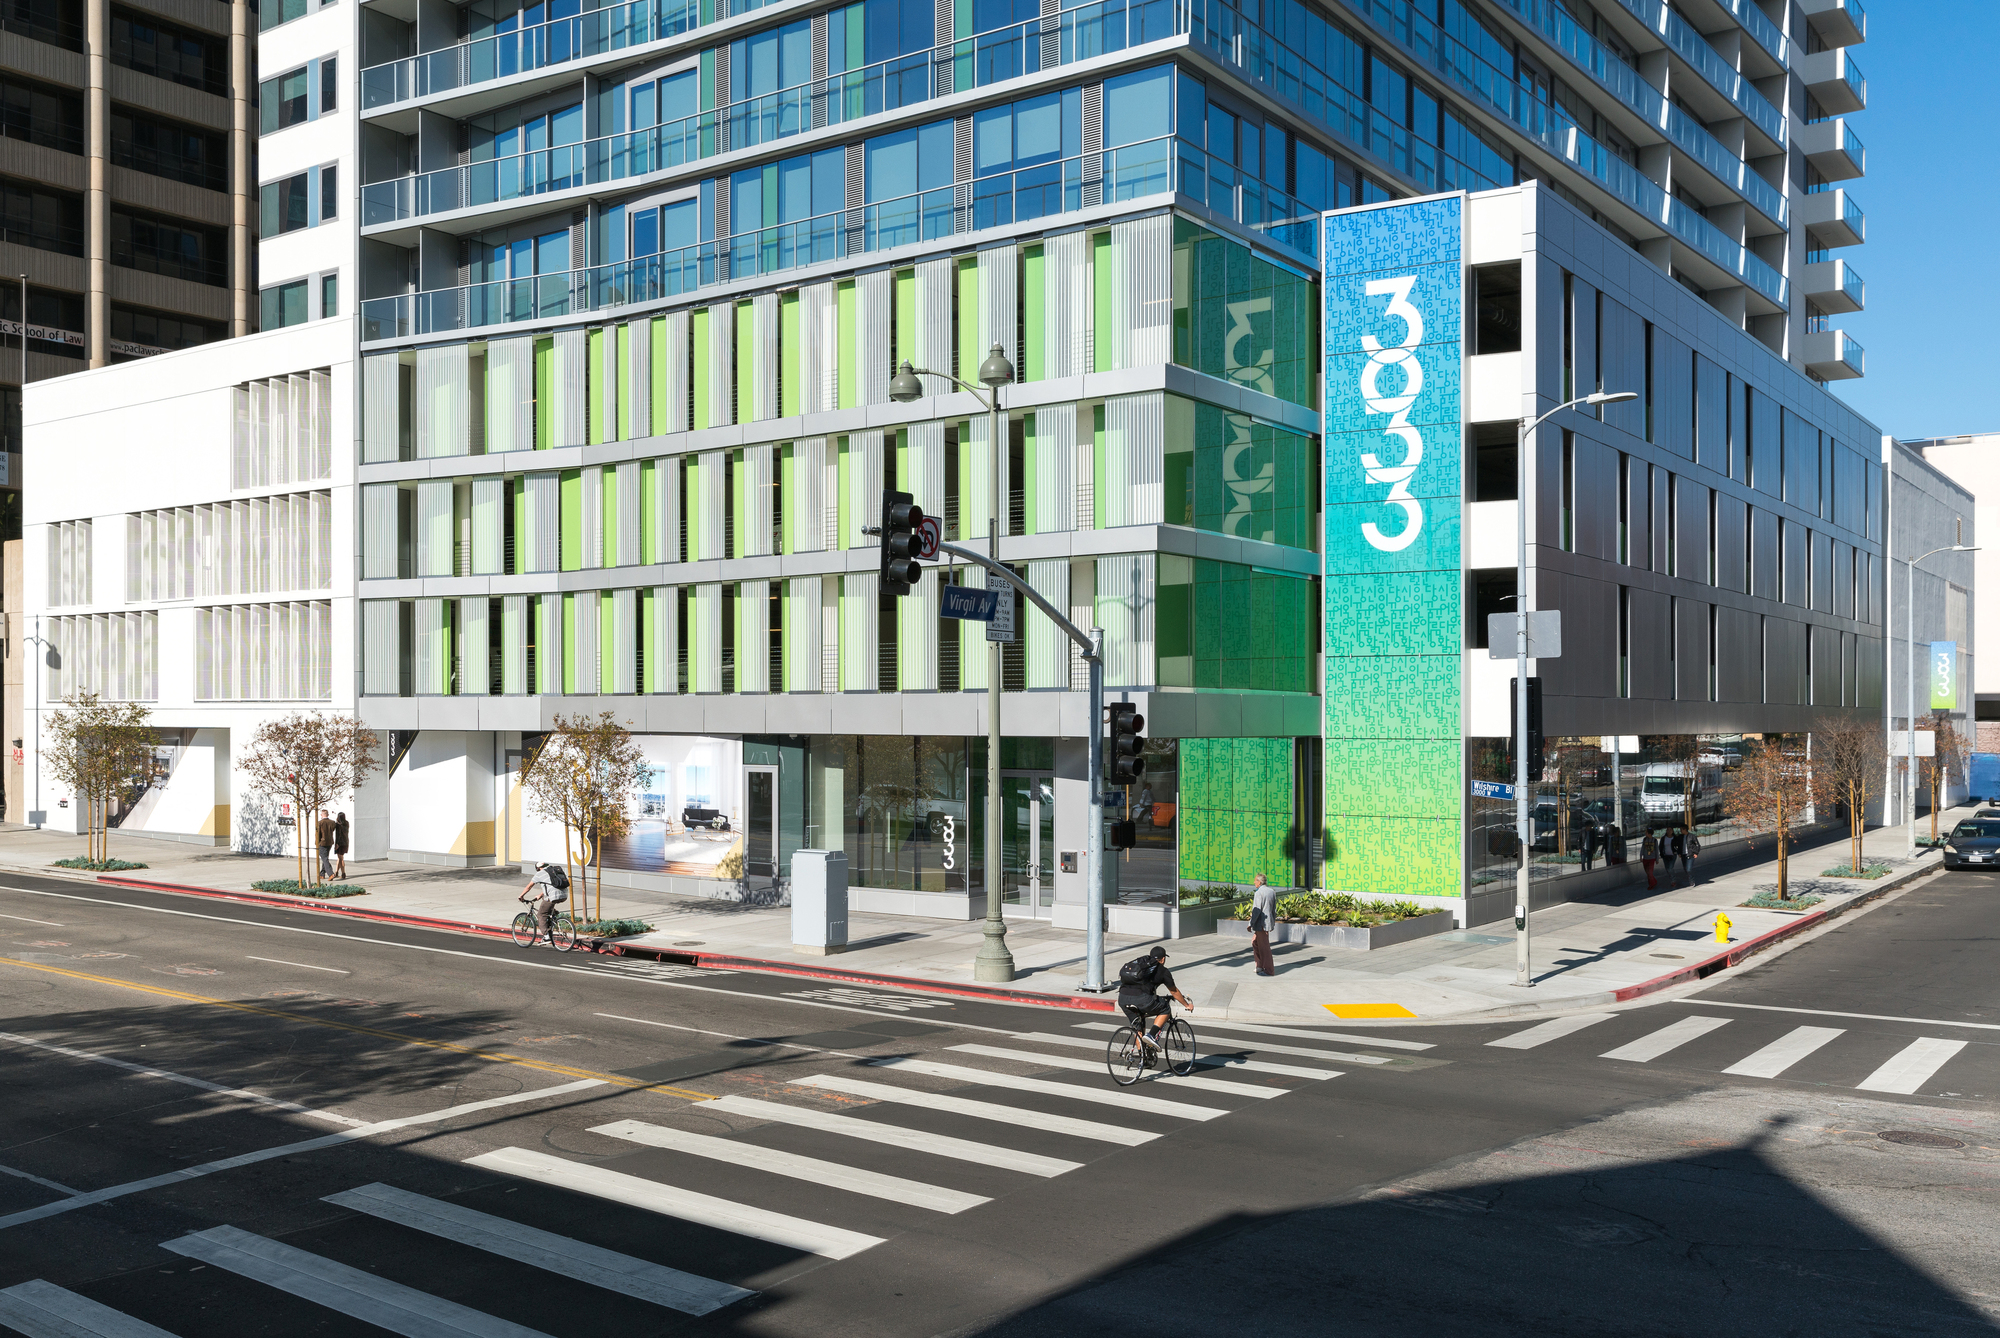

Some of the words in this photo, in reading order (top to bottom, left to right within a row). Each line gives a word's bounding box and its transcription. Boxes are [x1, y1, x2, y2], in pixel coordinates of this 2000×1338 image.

[49, 330, 59, 341] of
[63, 332, 82, 345] Law
[1361, 274, 1424, 552] 3033
[991, 579, 1011, 589] BUSES
[950, 594, 976, 617] Virgil
[977, 597, 991, 614] Av
[996, 600, 1008, 608] NLY
[1474, 781, 1500, 793] Wilshire
[1505, 785, 1513, 794] Bl
[943, 815, 955, 870] 3033
